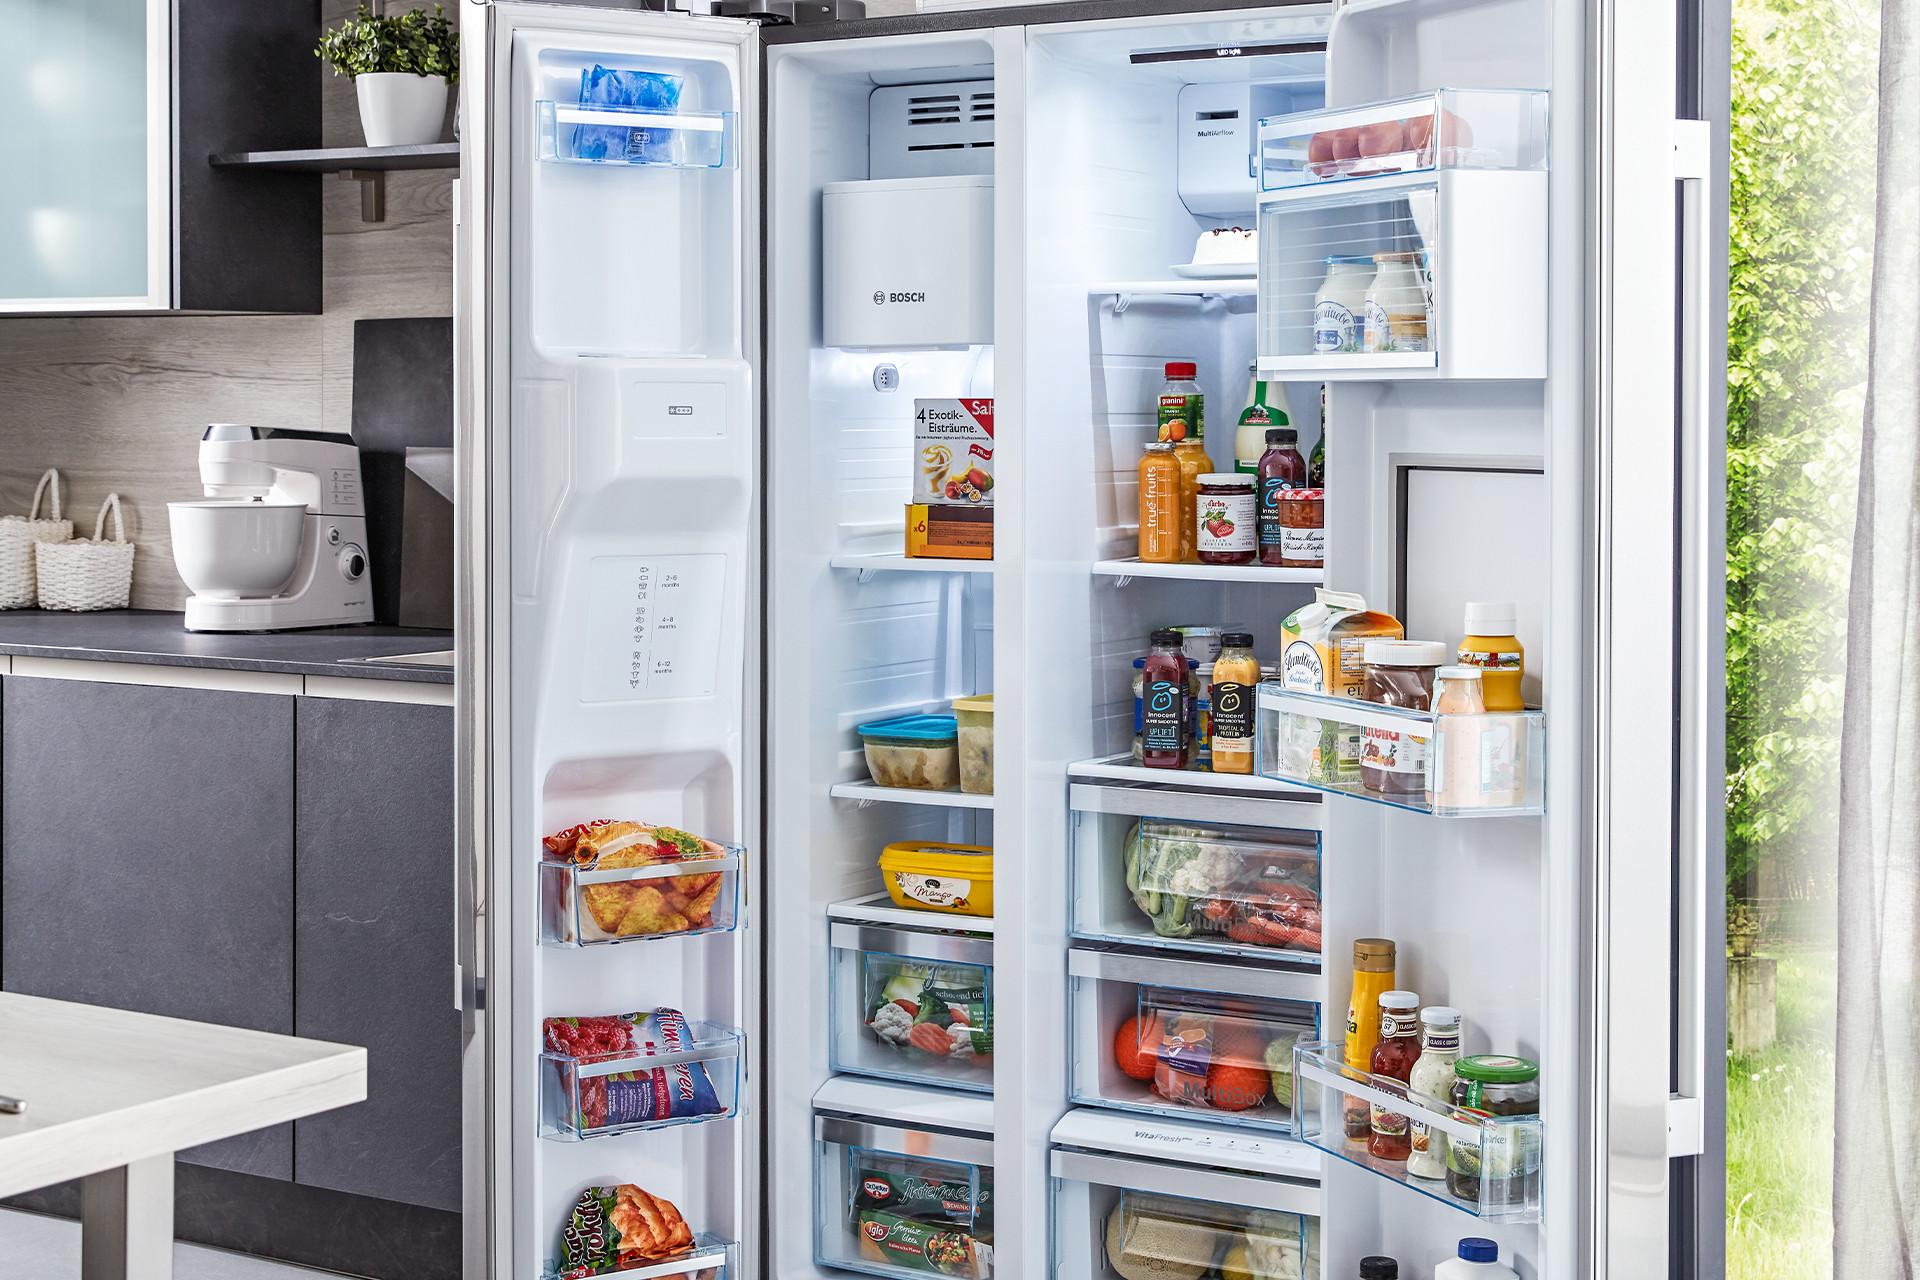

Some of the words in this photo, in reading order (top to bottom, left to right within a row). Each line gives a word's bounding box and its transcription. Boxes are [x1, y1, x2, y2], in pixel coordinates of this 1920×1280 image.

[889, 292, 925, 302] BOSCH
[916, 408, 926, 423] 4
[928, 409, 963, 420] Exotik-
[928, 422, 978, 433] Eisträume.
[1145, 465, 1157, 498] fruits
[913, 885, 953, 900] Mango
[656, 1011, 694, 1101] Himeren
[1183, 1080, 1267, 1108] MultiBox
[868, 1224, 884, 1237] iglo
